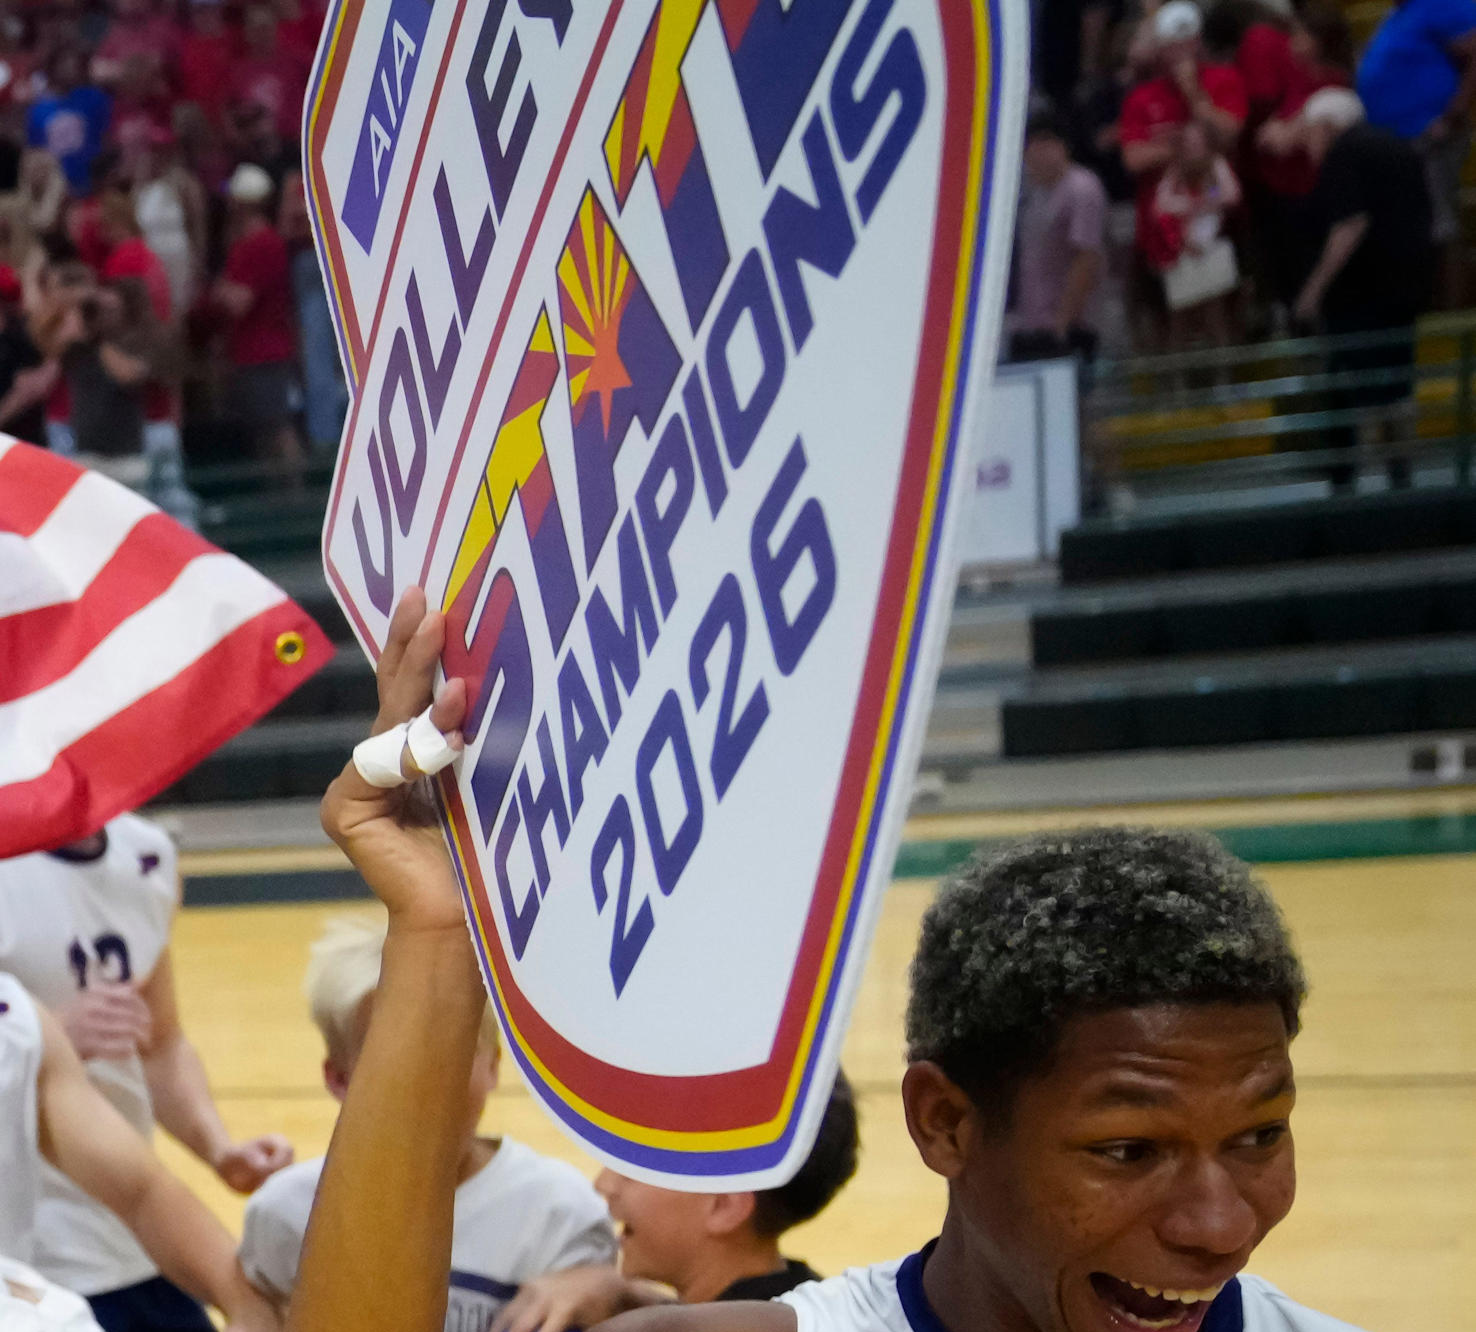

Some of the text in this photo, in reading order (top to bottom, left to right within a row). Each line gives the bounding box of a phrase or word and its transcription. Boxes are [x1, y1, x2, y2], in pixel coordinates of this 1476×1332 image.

[369, 18, 416, 200] AIA
[495, 0, 927, 962] CHAMPIONS
[590, 433, 838, 999] 2026
